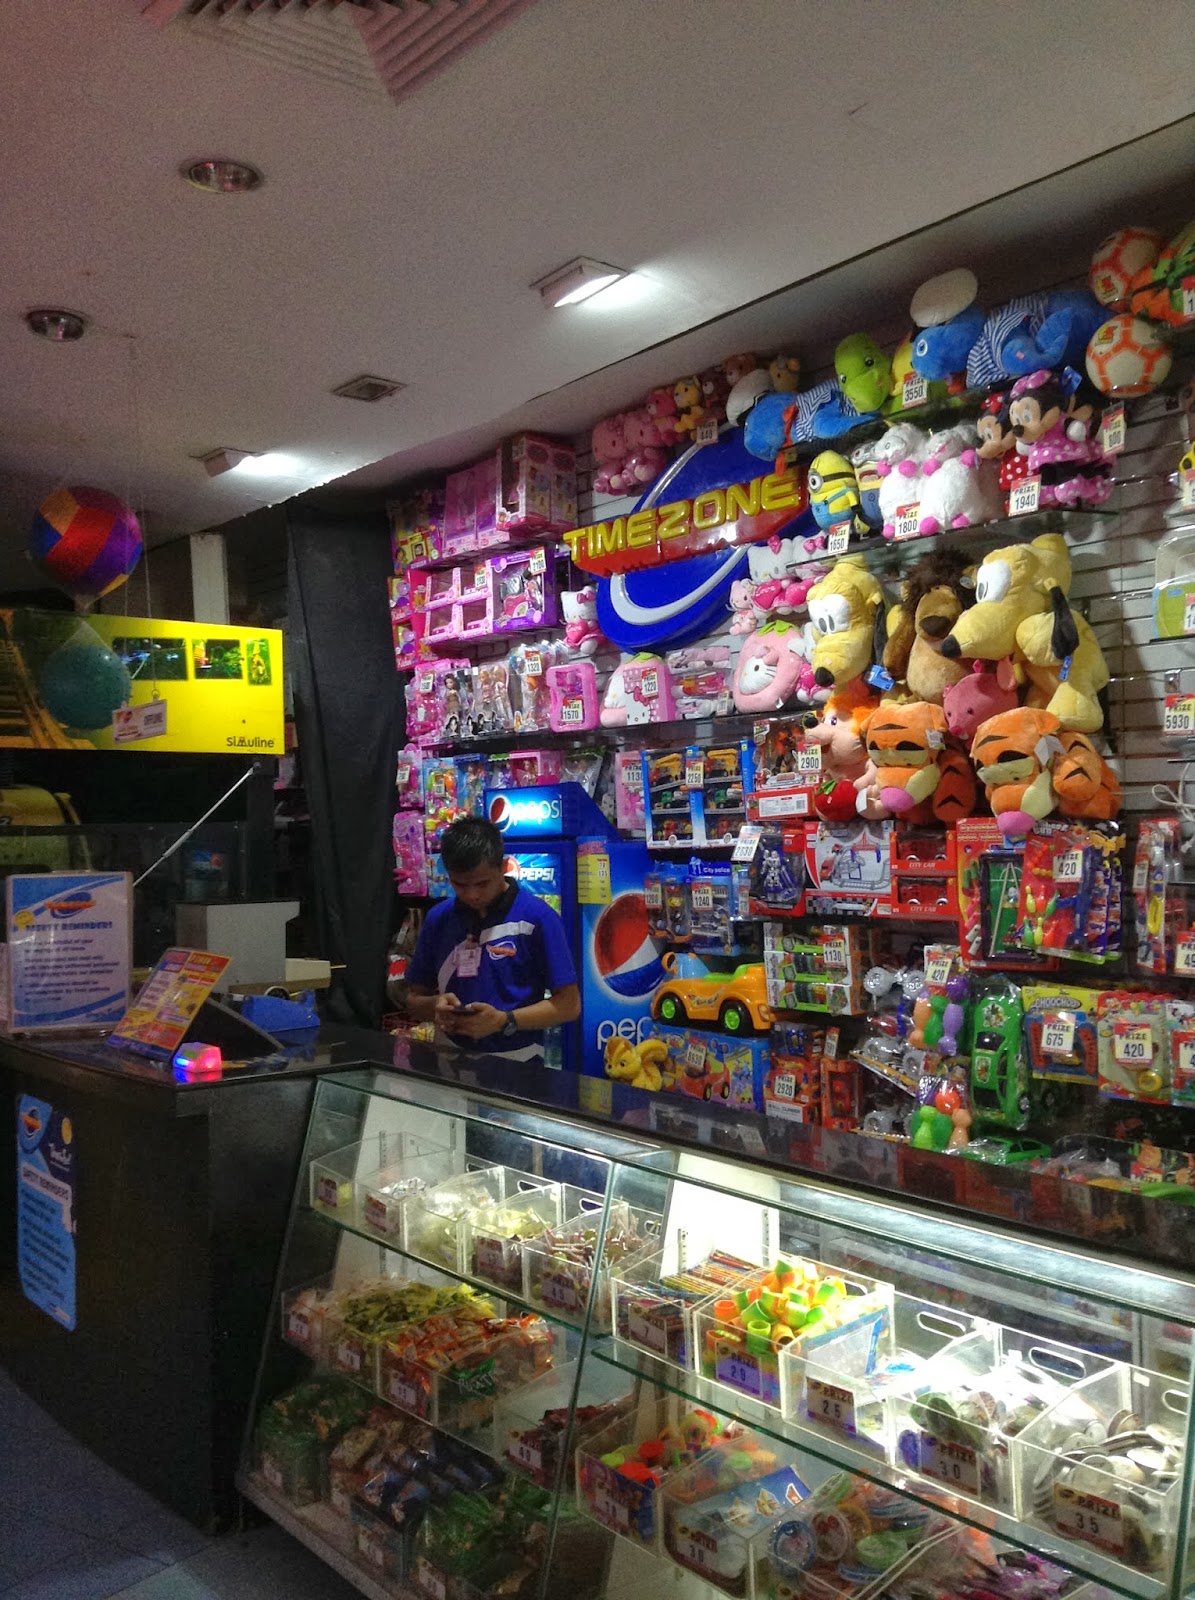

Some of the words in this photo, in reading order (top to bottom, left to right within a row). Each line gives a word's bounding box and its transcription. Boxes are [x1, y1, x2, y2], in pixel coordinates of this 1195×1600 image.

[905, 384, 924, 402] 3550
[1015, 484, 1035, 494] PRIZE
[1015, 493, 1036, 510] 1940
[563, 470, 799, 563] TIMEZONE
[899, 519, 918, 534] 1800
[830, 538, 845, 551] 1650
[527, 663, 540, 672] 1320
[645, 681, 656, 693] 1220
[1168, 703, 1192, 712] PRIZE
[563, 710, 579, 721] 1570
[1165, 714, 1189, 729] 5930
[800, 757, 820, 769] 2900
[687, 772, 702, 784] 2250
[1057, 853, 1078, 861] PRIZE
[519, 867, 555, 881] PEPSI
[703, 867, 714, 875] City
[1058, 862, 1076, 876] 420
[695, 895, 710, 907] 1240
[825, 949, 842, 962] 1130
[931, 959, 949, 967] PRIZE
[931, 969, 945, 980] 420
[1046, 1023, 1071, 1032] PRIZE
[1046, 1033, 1063, 1046] 675
[1119, 1033, 1146, 1041] PRIZE
[1124, 1042, 1144, 1058] 420
[777, 1074, 795, 1082] PRIZE
[777, 1083, 794, 1096] 2920
[730, 1365, 746, 1382] 20
[823, 1386, 853, 1406] PRIZE
[822, 1399, 841, 1418] 25
[940, 1443, 976, 1466] PRIZE
[940, 1460, 961, 1479] 30
[1077, 1494, 1121, 1520] PRIZE
[1075, 1512, 1099, 1534] 35
